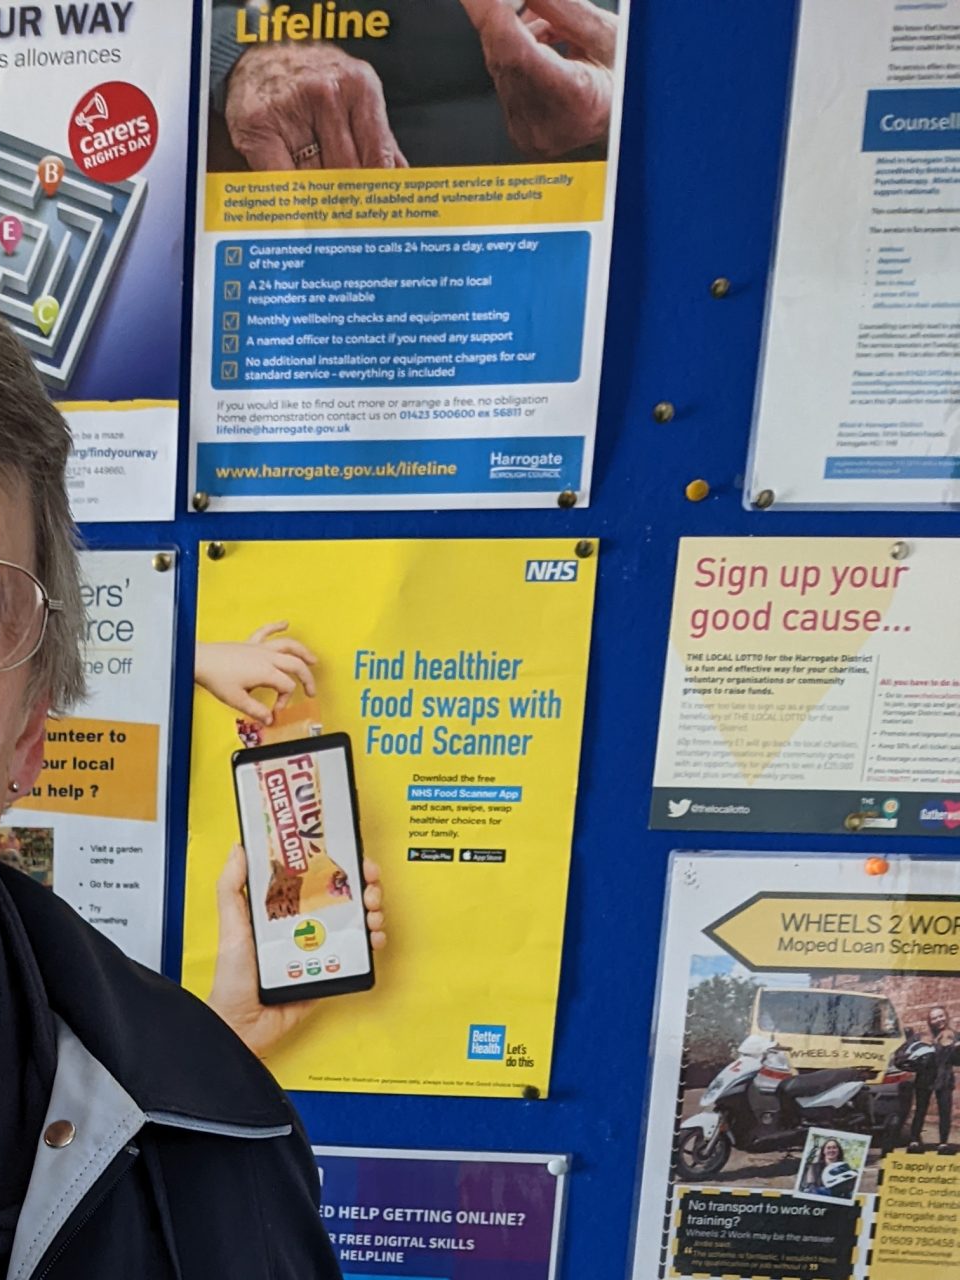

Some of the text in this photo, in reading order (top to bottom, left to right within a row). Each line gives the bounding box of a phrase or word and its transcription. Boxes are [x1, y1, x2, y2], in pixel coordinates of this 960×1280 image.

[56, 2, 134, 34] WAY
[236, 6, 390, 43] Lifeline
[15, 48, 121, 67] allowances
[84, 135, 152, 169] RIGHTS DAY
[45, 164, 58, 183] B
[3, 222, 15, 240] E
[38, 304, 53, 324] C
[248, 309, 509, 326] Monthly wellbeing checks and equipment testing
[490, 452, 563, 467] Harrogate
[215, 461, 457, 480] www.harrogate.gov.uk/lifeline
[526, 561, 577, 580] NHS
[694, 557, 910, 596] Sign up your
[690, 602, 912, 639] good cause...
[108, 658, 131, 674] Off
[355, 650, 523, 680] Find healthier
[687, 654, 872, 664] THE LOCAL LOTTO for the Harrogate District
[361, 689, 561, 725] food swaps with
[109, 730, 126, 743] to
[367, 726, 532, 755] Food Scanner
[73, 758, 114, 771] local
[413, 774, 495, 783] Download the free
[47, 785, 99, 799] help ?
[411, 789, 518, 799] NHS Food Scanner App
[267, 773, 306, 871] CHEW LOAF
[782, 912, 882, 934] WHEELS
[889, 915, 900, 934] 2
[778, 937, 958, 955] Moped Loan Scheme
[472, 1030, 501, 1042] Better
[472, 1042, 501, 1055] Health
[791, 1050, 839, 1058] WHEELS
[854, 1052, 886, 1062] WORK
[506, 1057, 534, 1067] do this
[338, 1206, 525, 1226] HELP GETTING ONLINE?
[689, 1200, 826, 1216] No transport to work or
[687, 1215, 740, 1228] training?
[339, 1234, 474, 1250] FREE DIGITAL SKILLS
[341, 1250, 404, 1263] HELPLINE
